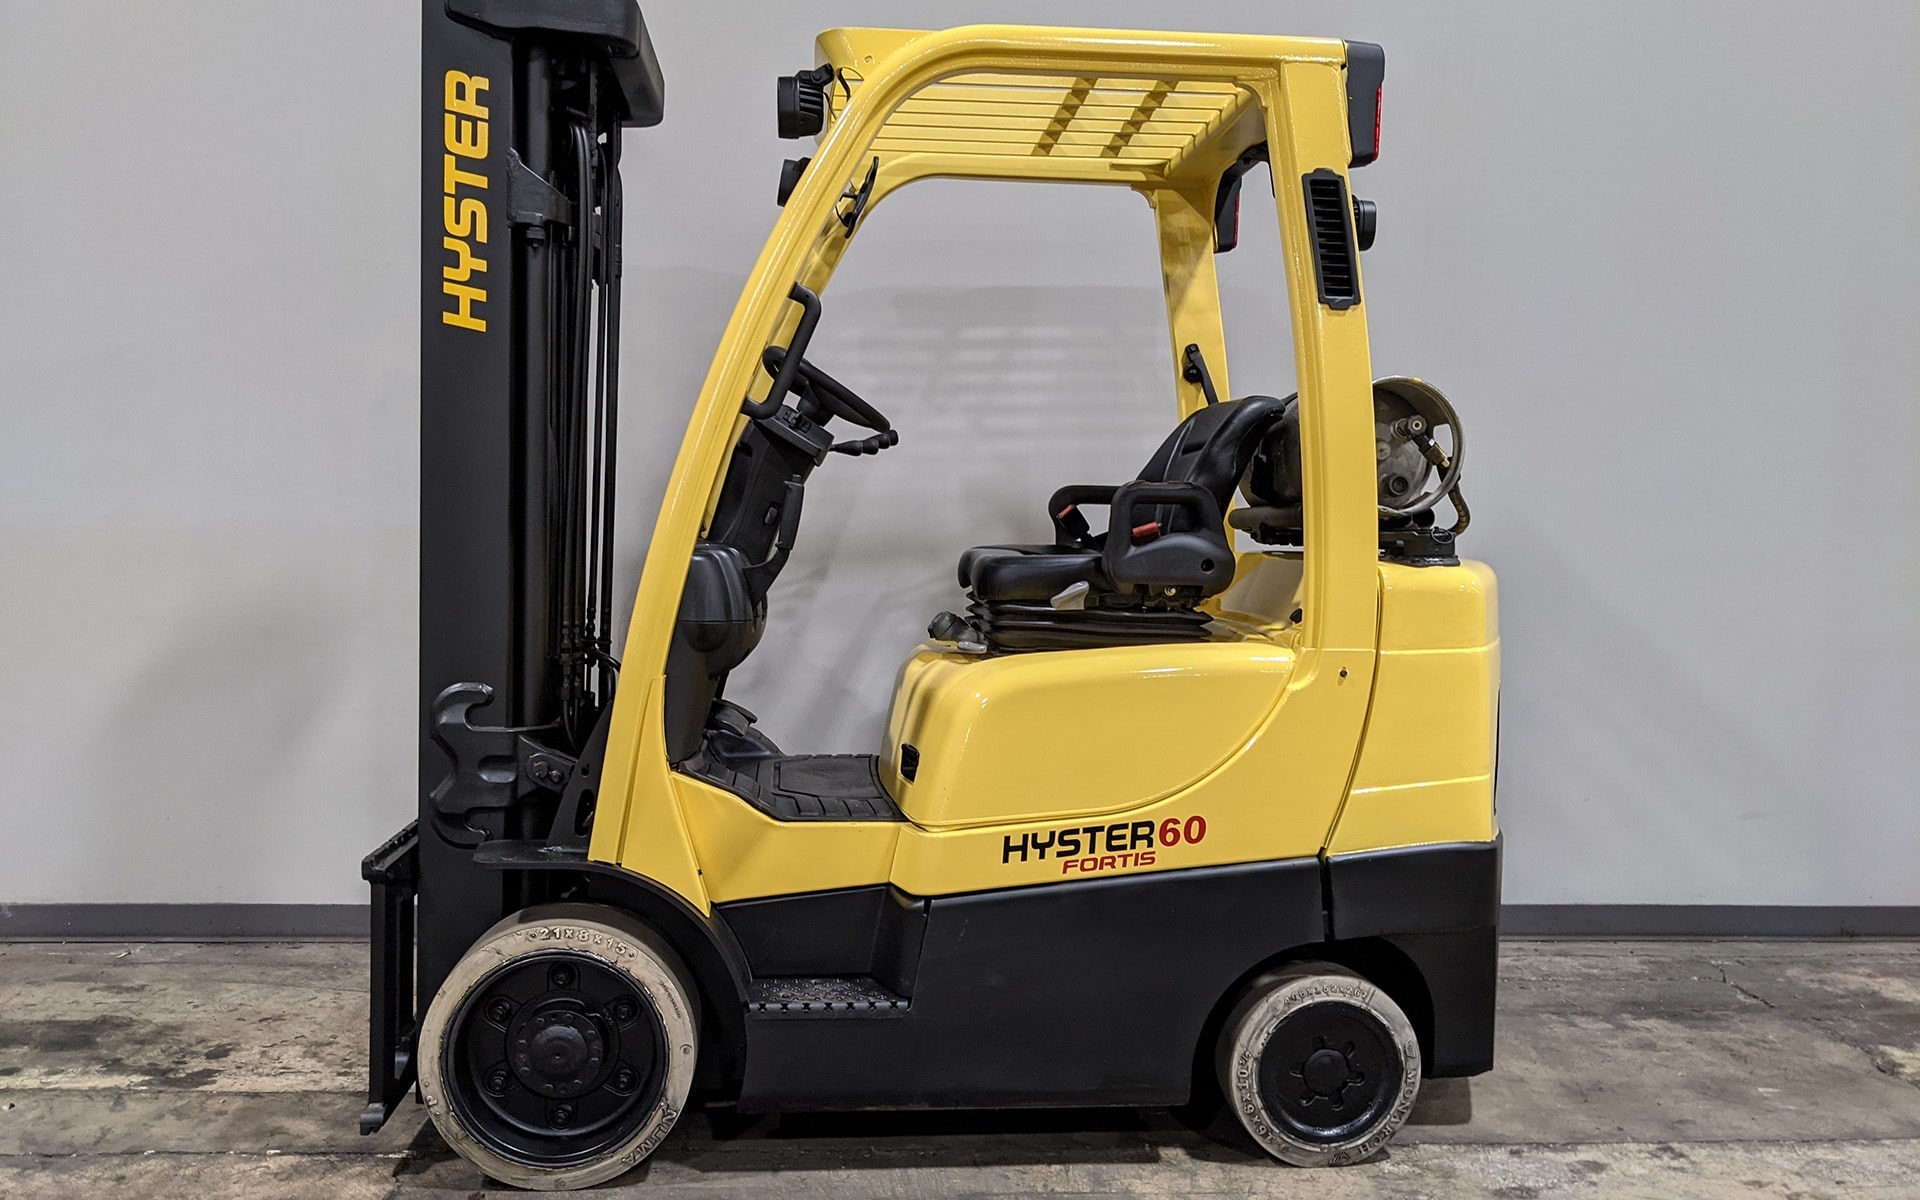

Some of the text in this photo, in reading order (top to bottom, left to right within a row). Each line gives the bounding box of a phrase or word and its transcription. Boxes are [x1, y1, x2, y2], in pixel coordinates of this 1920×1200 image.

[443, 69, 490, 333] HYSTER
[1002, 815, 1207, 864] HYSTER 60
[1062, 851, 1156, 875] FORTIS
[1359, 1068, 1417, 1154] MONARCH
